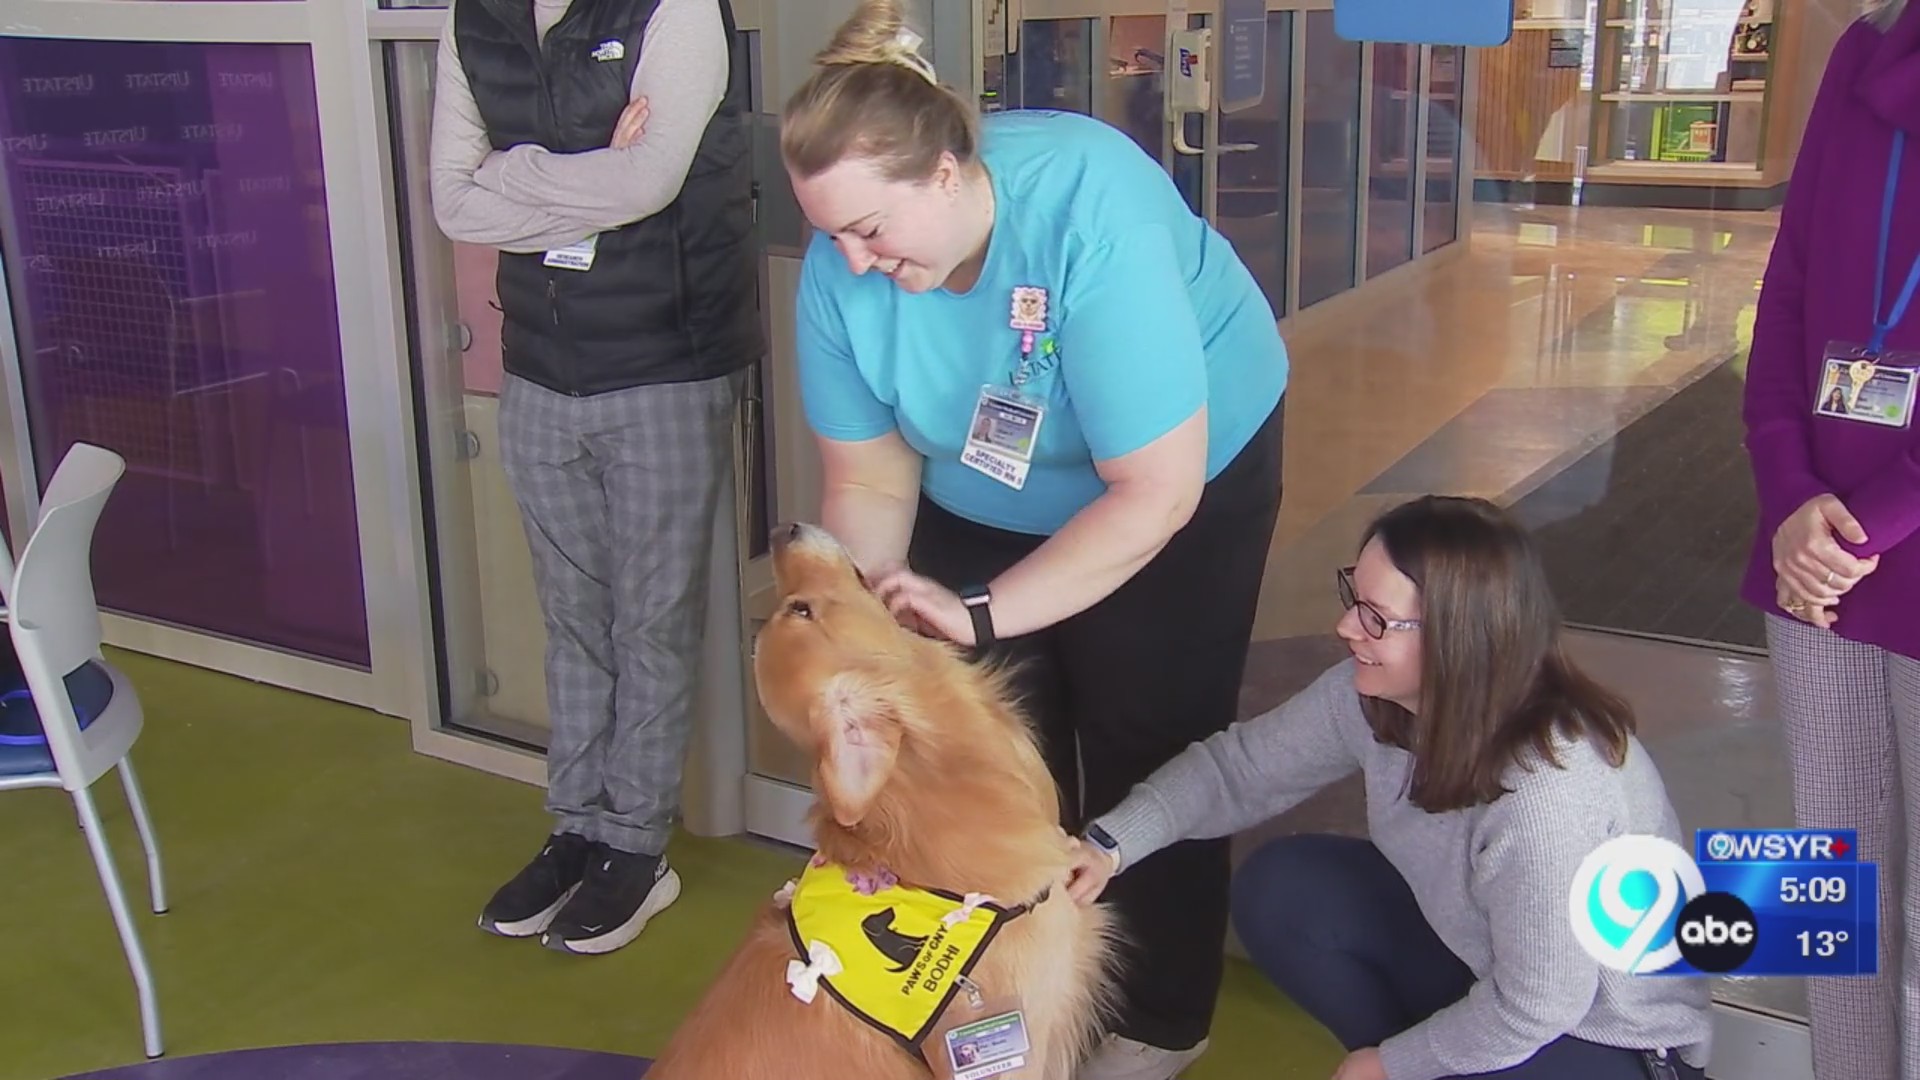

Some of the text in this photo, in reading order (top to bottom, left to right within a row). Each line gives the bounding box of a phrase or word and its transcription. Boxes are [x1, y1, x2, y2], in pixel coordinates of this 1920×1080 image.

[963, 452, 1003, 476] CERTIFIED
[976, 449, 1016, 473] SPECIALTY
[901, 961, 926, 995] PAWS
[929, 924, 948, 950] CNY
[923, 944, 960, 992] BODHI
[964, 1061, 1012, 1079] VOLUNTEER
